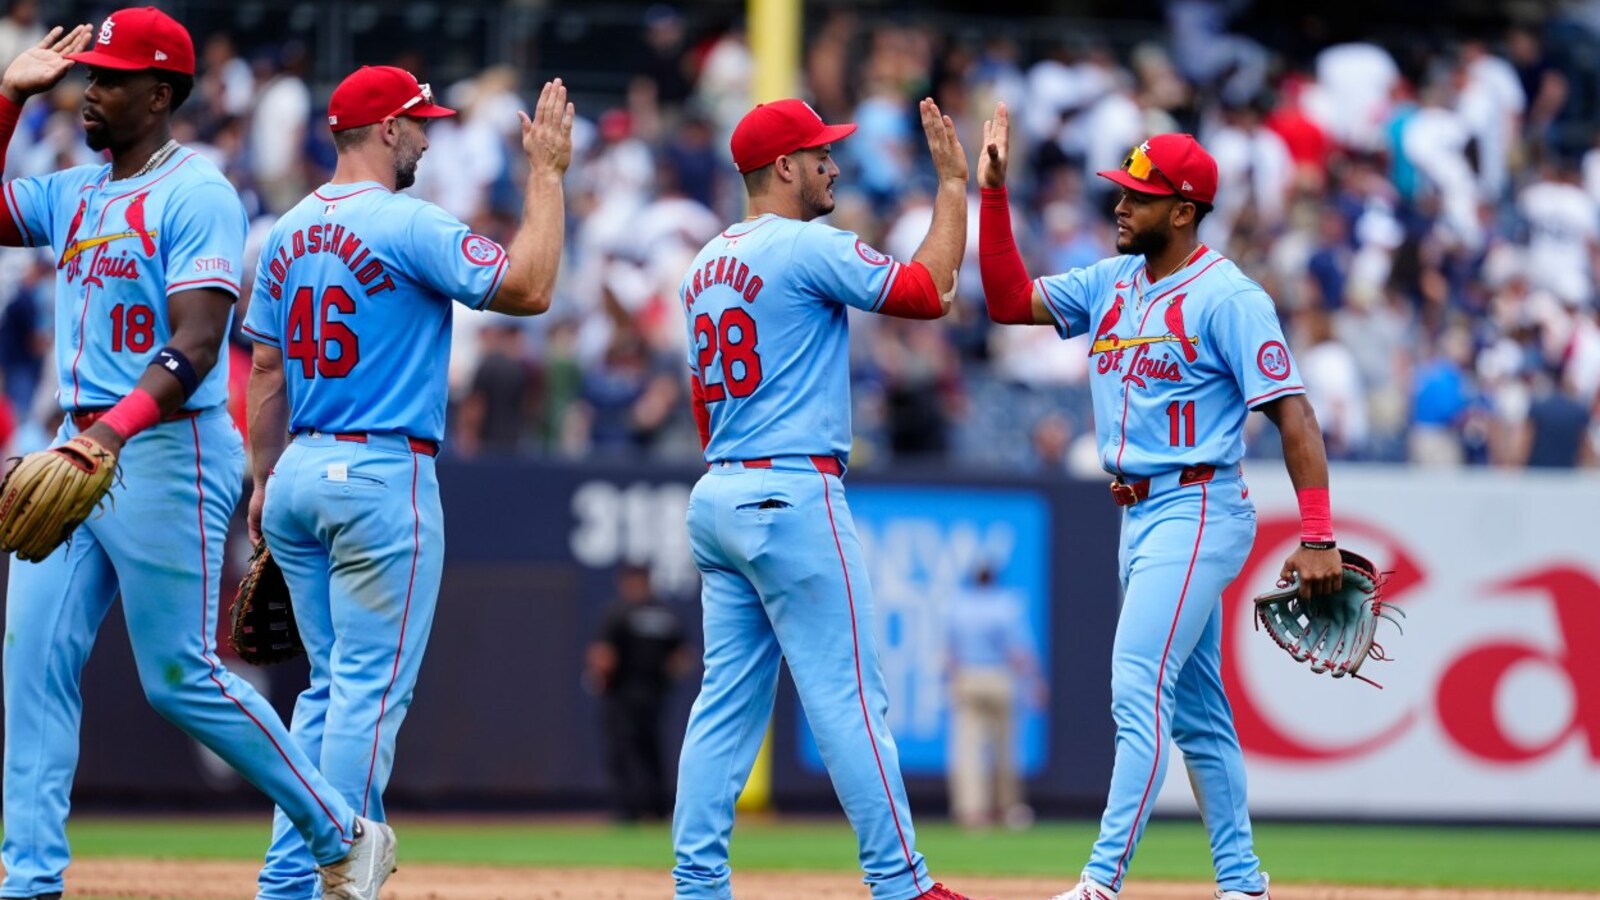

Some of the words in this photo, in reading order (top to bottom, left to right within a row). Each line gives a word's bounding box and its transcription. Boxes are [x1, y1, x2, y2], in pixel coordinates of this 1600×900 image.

[82, 241, 140, 290] Louis
[194, 257, 233, 275] STIFEL
[267, 223, 397, 301] GOLDSCHMIDT
[684, 255, 764, 312] ARENADO
[109, 302, 155, 354] 18
[286, 285, 360, 379] 46
[693, 306, 763, 404] 28
[1121, 342, 1183, 390] Louis
[1165, 400, 1196, 448] 11
